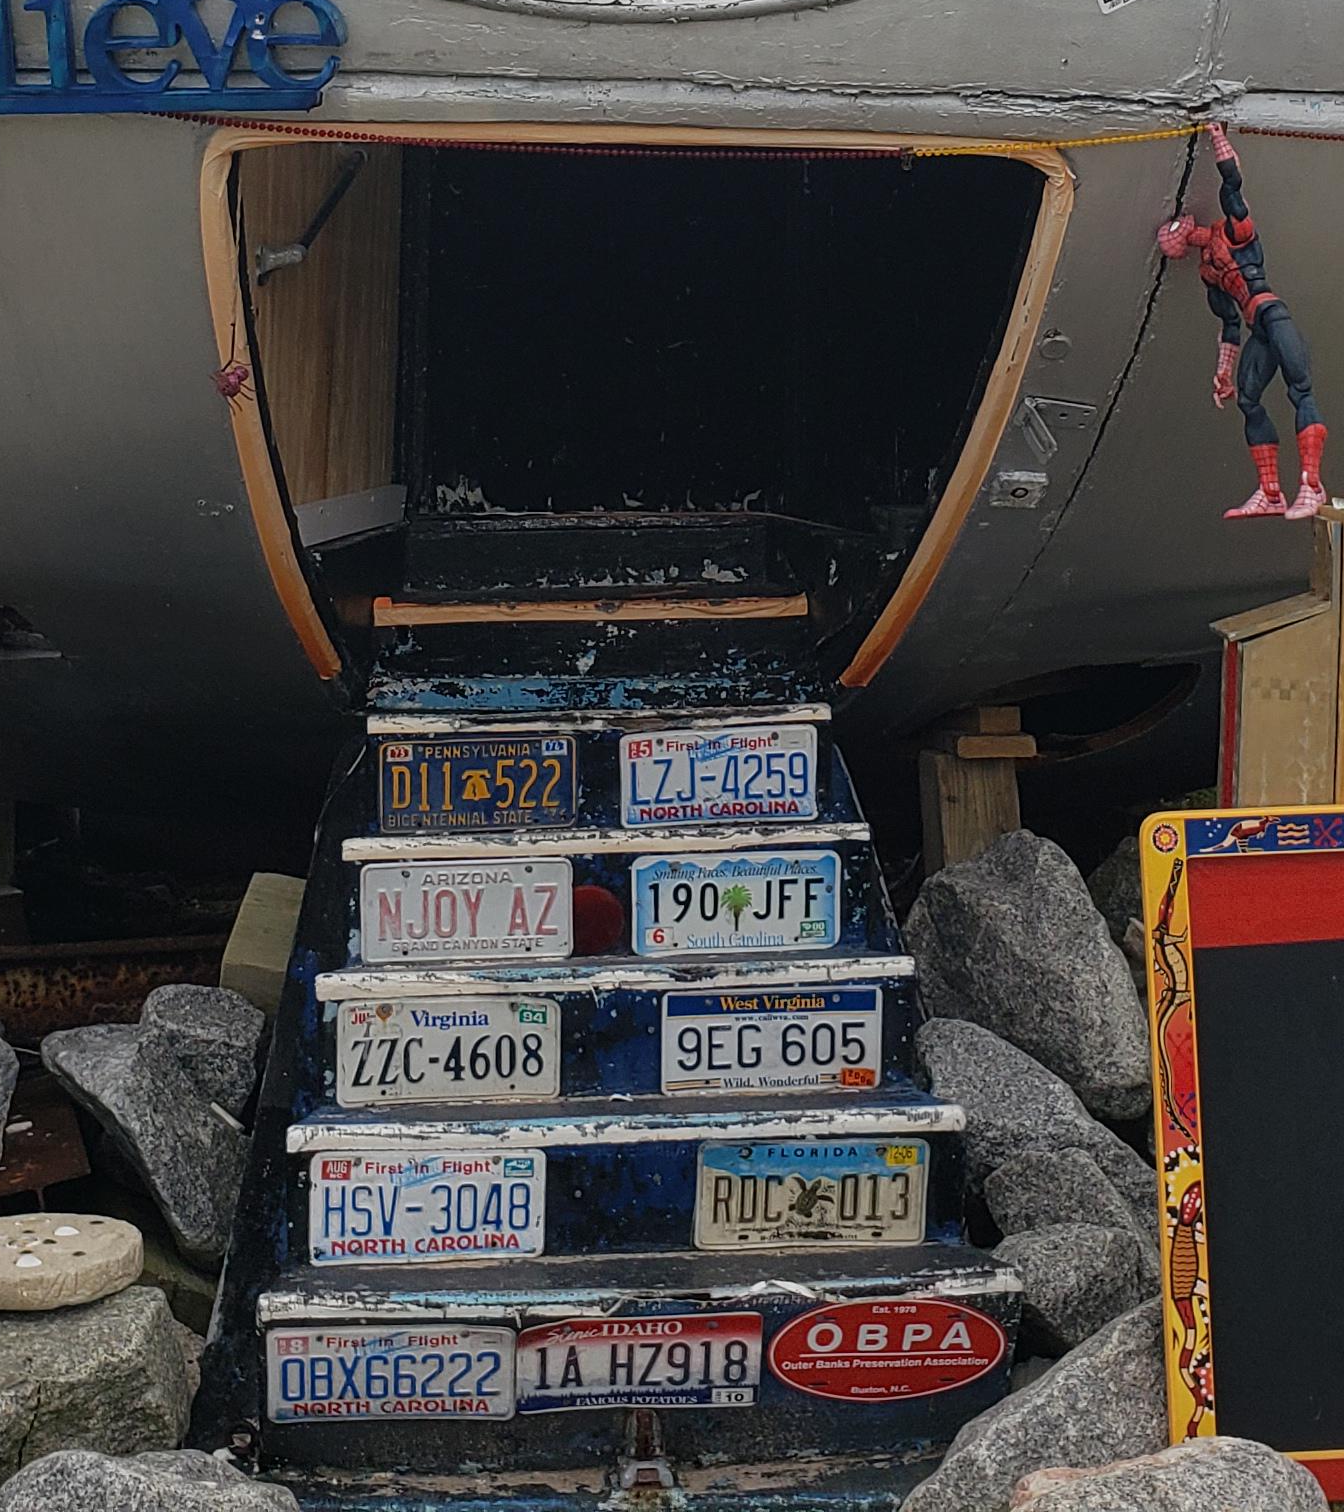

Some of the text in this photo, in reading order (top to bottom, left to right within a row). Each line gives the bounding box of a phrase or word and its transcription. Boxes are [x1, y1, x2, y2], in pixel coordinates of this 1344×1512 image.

[424, 743, 530, 759] PENNSYLVANIA
[639, 741, 651, 758] 5
[666, 736, 773, 752] First in Flight
[391, 758, 561, 812] D11 522
[630, 751, 809, 806] LZJ-4259
[388, 812, 488, 828] BICENTENNIAL
[493, 810, 533, 824] STATE
[639, 800, 800, 821] NORTH CAROLINA
[421, 870, 513, 887] ARIZONA
[654, 870, 695, 882] Smiling
[732, 865, 781, 878] Beautiful
[648, 878, 825, 924] 190 JFF
[378, 884, 559, 941] NJOY AZ
[392, 937, 544, 952] GRAND CANYON STATE
[652, 928, 665, 944] 6
[686, 931, 785, 949] South Carolina
[720, 994, 825, 1012] West Virginia
[411, 1009, 489, 1030] Virginia
[522, 1012, 544, 1023] 94
[677, 1021, 866, 1072] 9EG 605
[350, 1033, 544, 1088] ZZC-4608
[758, 1074, 819, 1087] Wonderful
[767, 1147, 859, 1158] FLORIDA
[327, 1162, 348, 1173] AUG
[364, 1162, 402, 1175] First
[414, 1162, 430, 1174] in
[442, 1160, 491, 1175] Flight
[323, 1182, 531, 1238] HSV-3048
[331, 1233, 520, 1256] NORTH CAROLINA
[871, 1305, 891, 1314] Est.
[327, 1335, 459, 1348] First in Flight
[547, 1320, 683, 1345] Scenic IDAHO
[534, 1340, 748, 1390] 1A HZ918
[782, 1356, 989, 1371] Outer Banks Preservation Association
[281, 1351, 502, 1402] OBX66222
[851, 1385, 888, 1394] Buxton,
[293, 1398, 490, 1416] NORTH CAROLINA
[575, 1395, 628, 1406] FAMOUS
[632, 1394, 698, 1405] POTATOES
[725, 1392, 745, 1402] 10
